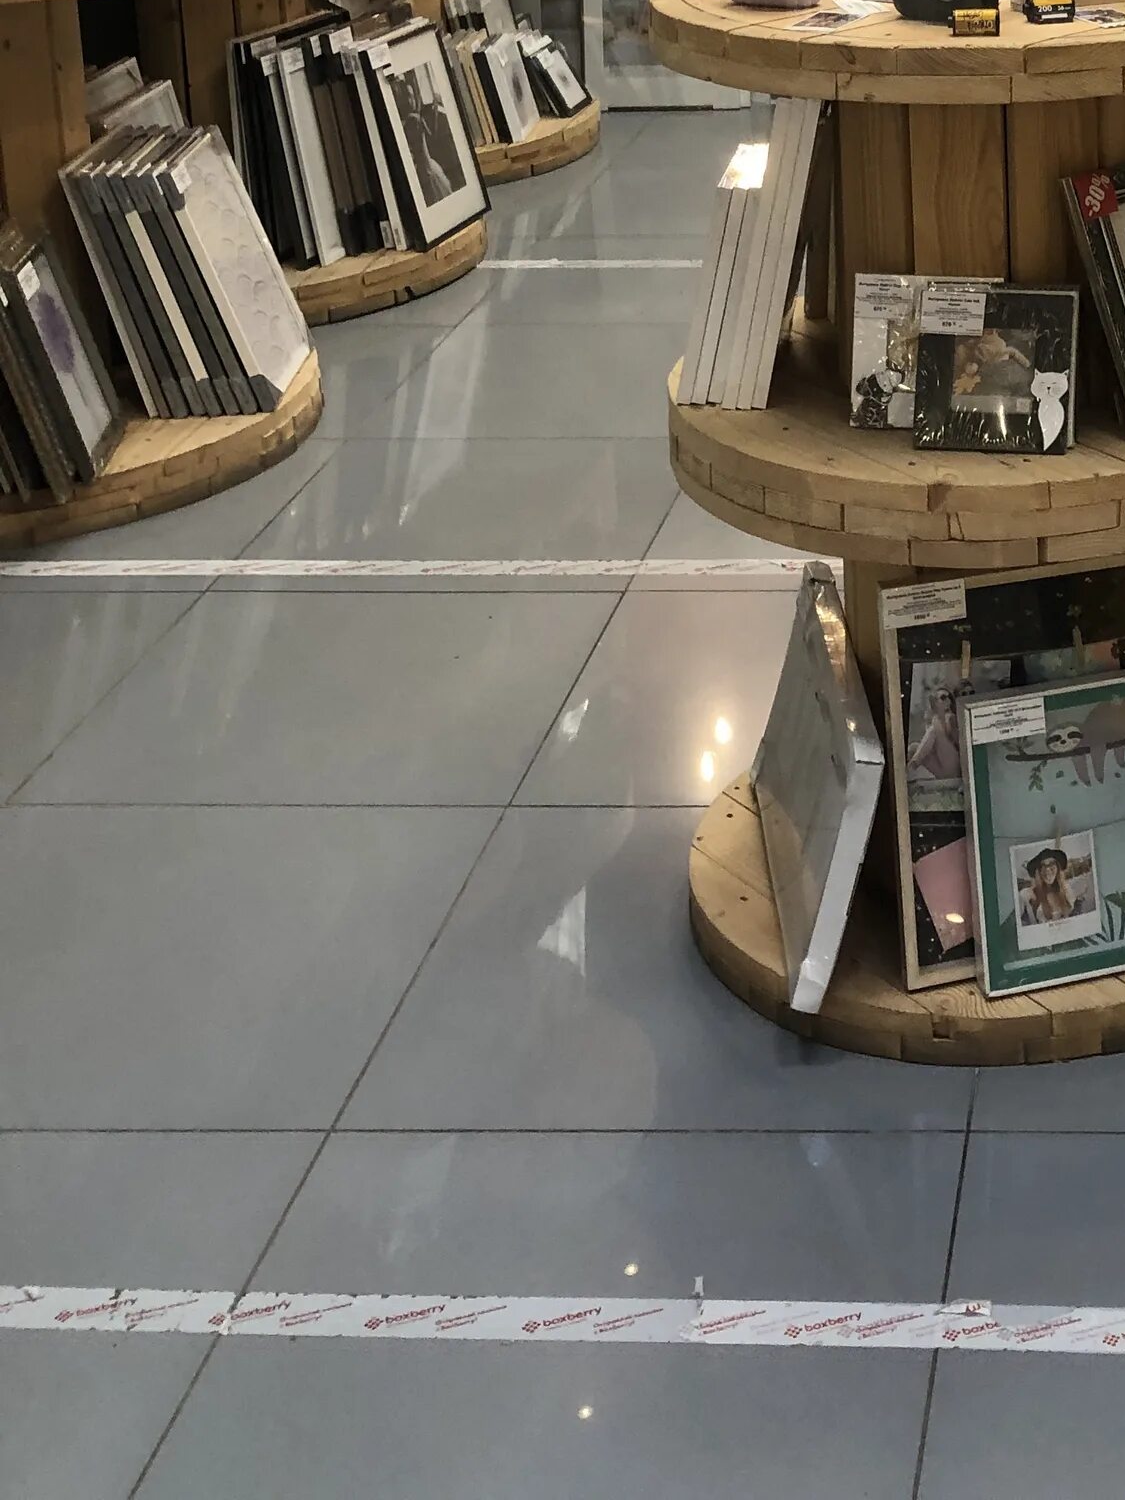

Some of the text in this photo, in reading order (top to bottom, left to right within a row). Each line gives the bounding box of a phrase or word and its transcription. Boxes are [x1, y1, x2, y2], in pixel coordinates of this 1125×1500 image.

[1084, 172, 1110, 217] -30%
[231, 1300, 292, 1322] boxberry
[384, 1303, 446, 1325] boxberry
[542, 1306, 602, 1328] boxberry
[804, 1312, 863, 1332] boxberry
